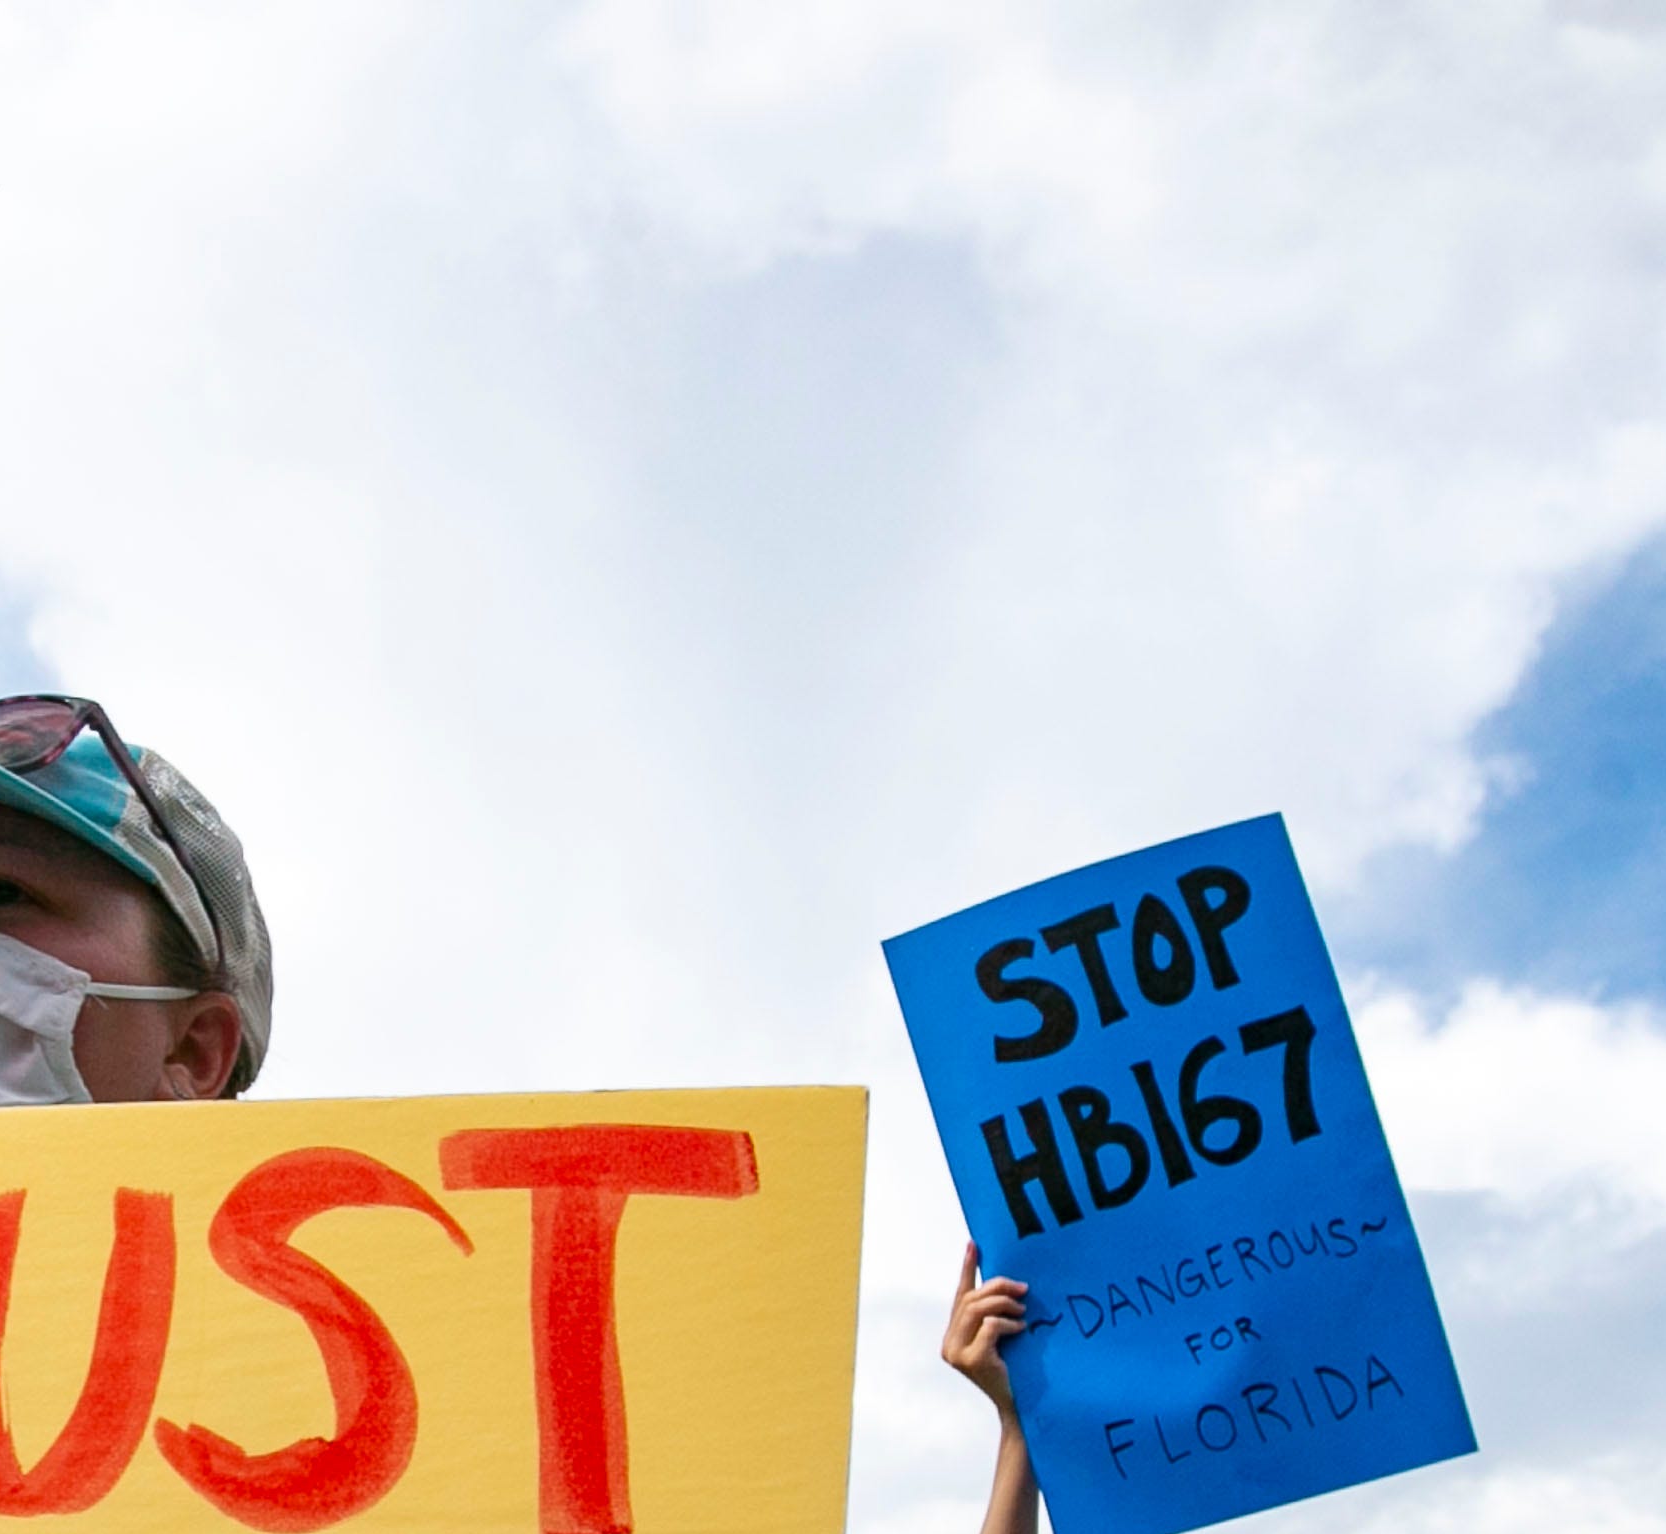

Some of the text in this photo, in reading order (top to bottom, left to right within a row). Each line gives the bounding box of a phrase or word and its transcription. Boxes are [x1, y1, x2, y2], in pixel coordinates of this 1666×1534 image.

[973, 864, 1252, 1064] STOP
[978, 1004, 1322, 1240] HB167
[1103, 1353, 1405, 1480] FLORIDA
[1183, 1315, 1263, 1366] FOR
